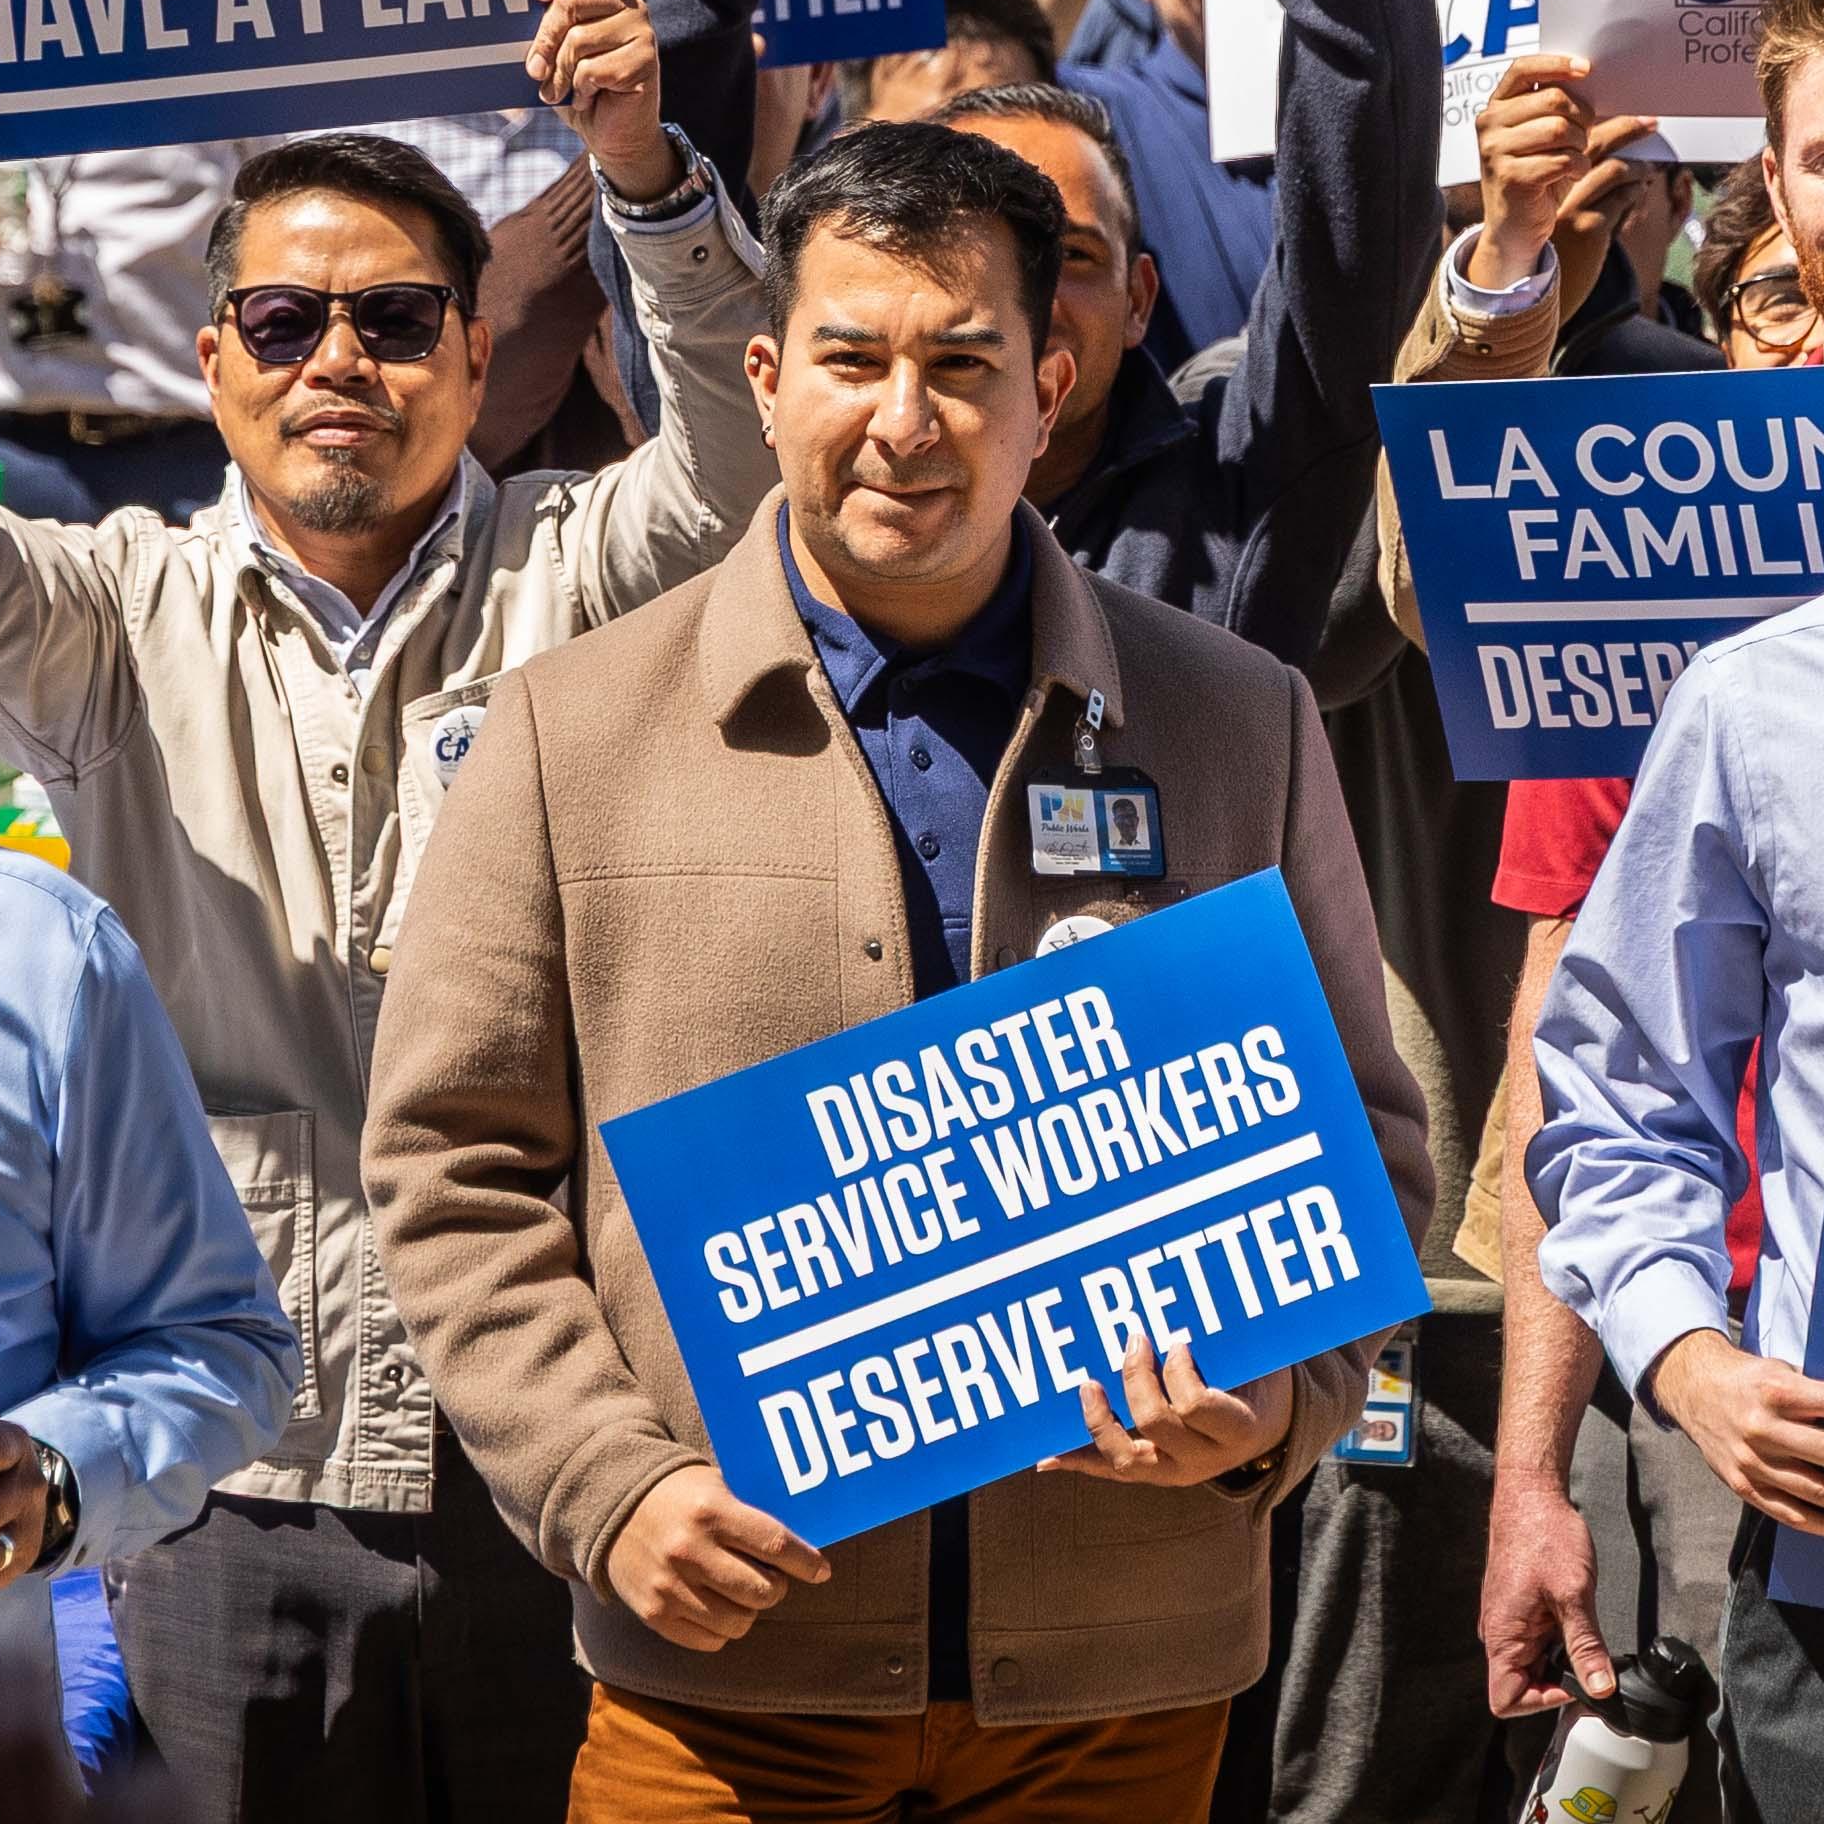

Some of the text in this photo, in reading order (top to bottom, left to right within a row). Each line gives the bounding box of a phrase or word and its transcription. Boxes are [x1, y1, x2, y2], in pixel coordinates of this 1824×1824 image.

[1428, 426, 1560, 500] LA
[1478, 641, 1696, 730] DESER
[1041, 823, 1090, 834] Public Works
[806, 985, 1132, 1180] DISASTER
[704, 1024, 1302, 1324] SERVICE WORKERS
[759, 1184, 1360, 1496] DESERVE BETTER
